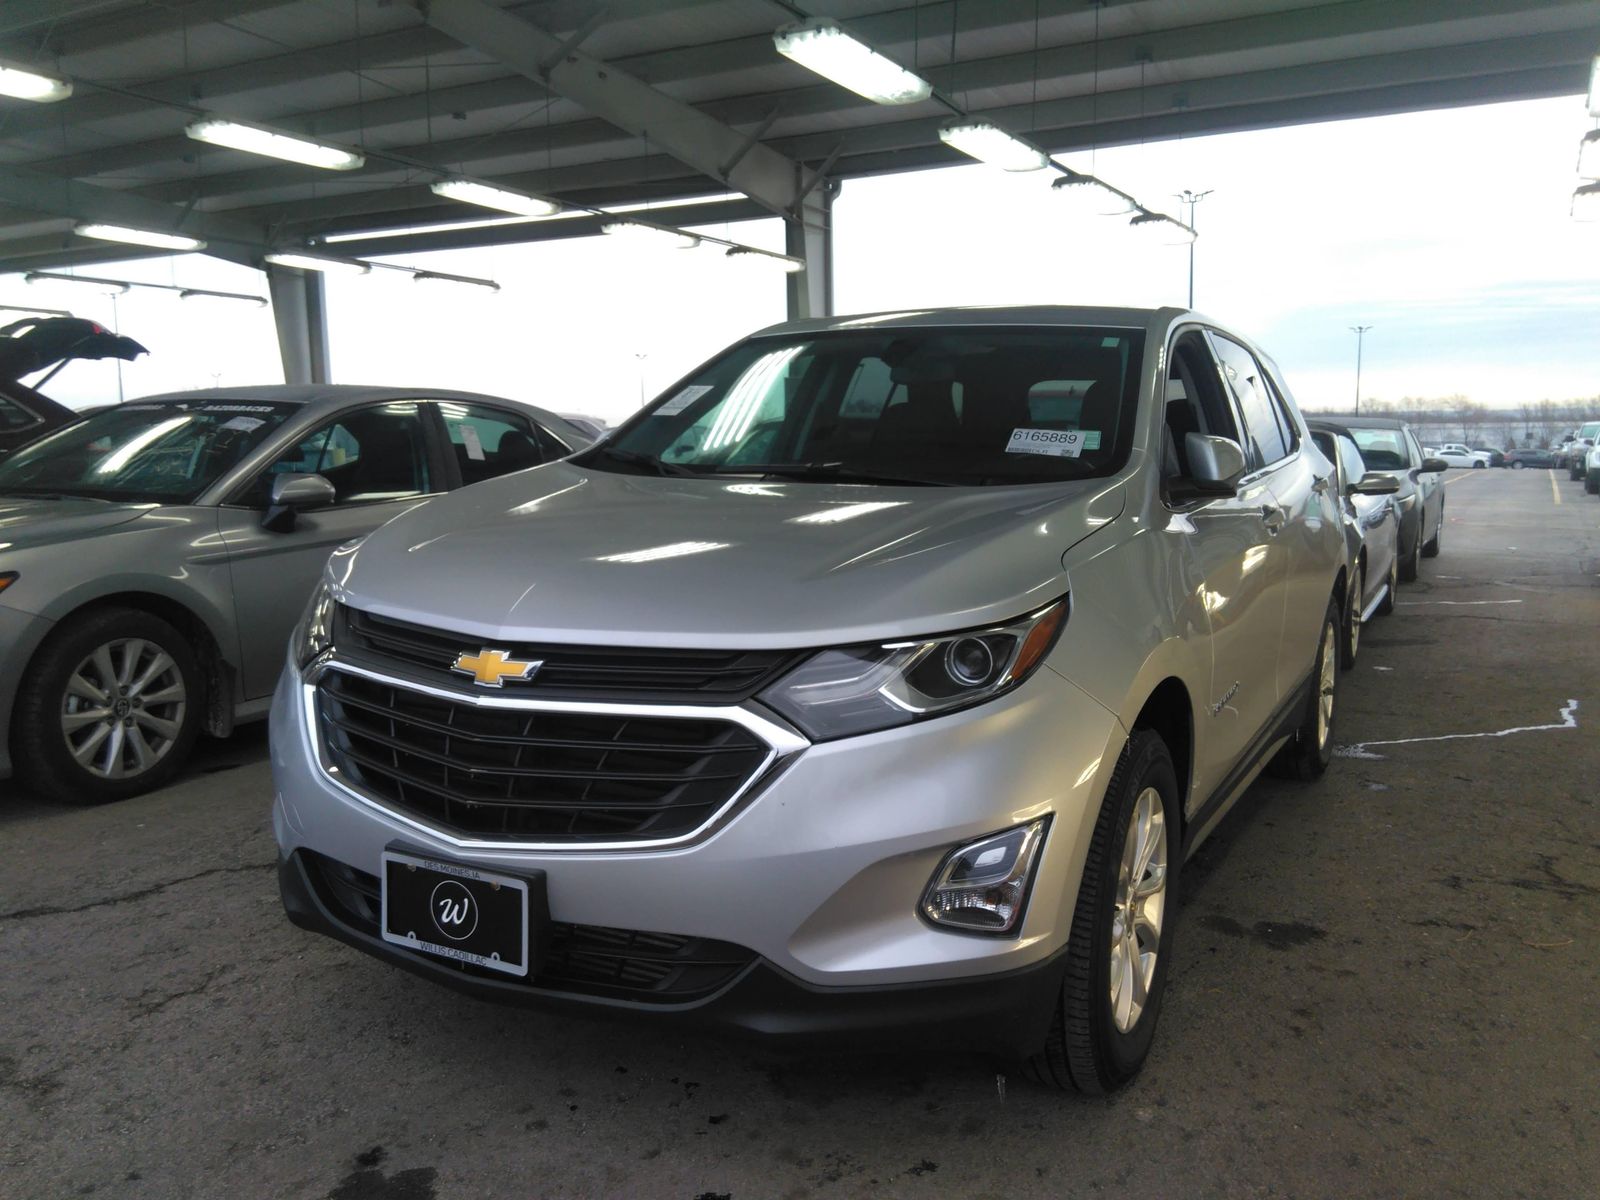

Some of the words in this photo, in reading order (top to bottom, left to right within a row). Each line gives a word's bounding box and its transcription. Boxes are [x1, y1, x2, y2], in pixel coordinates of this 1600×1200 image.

[1013, 430, 1077, 444] 6165889
[420, 941, 446, 955] WILLIS
[447, 948, 487, 966] CADILLAC
